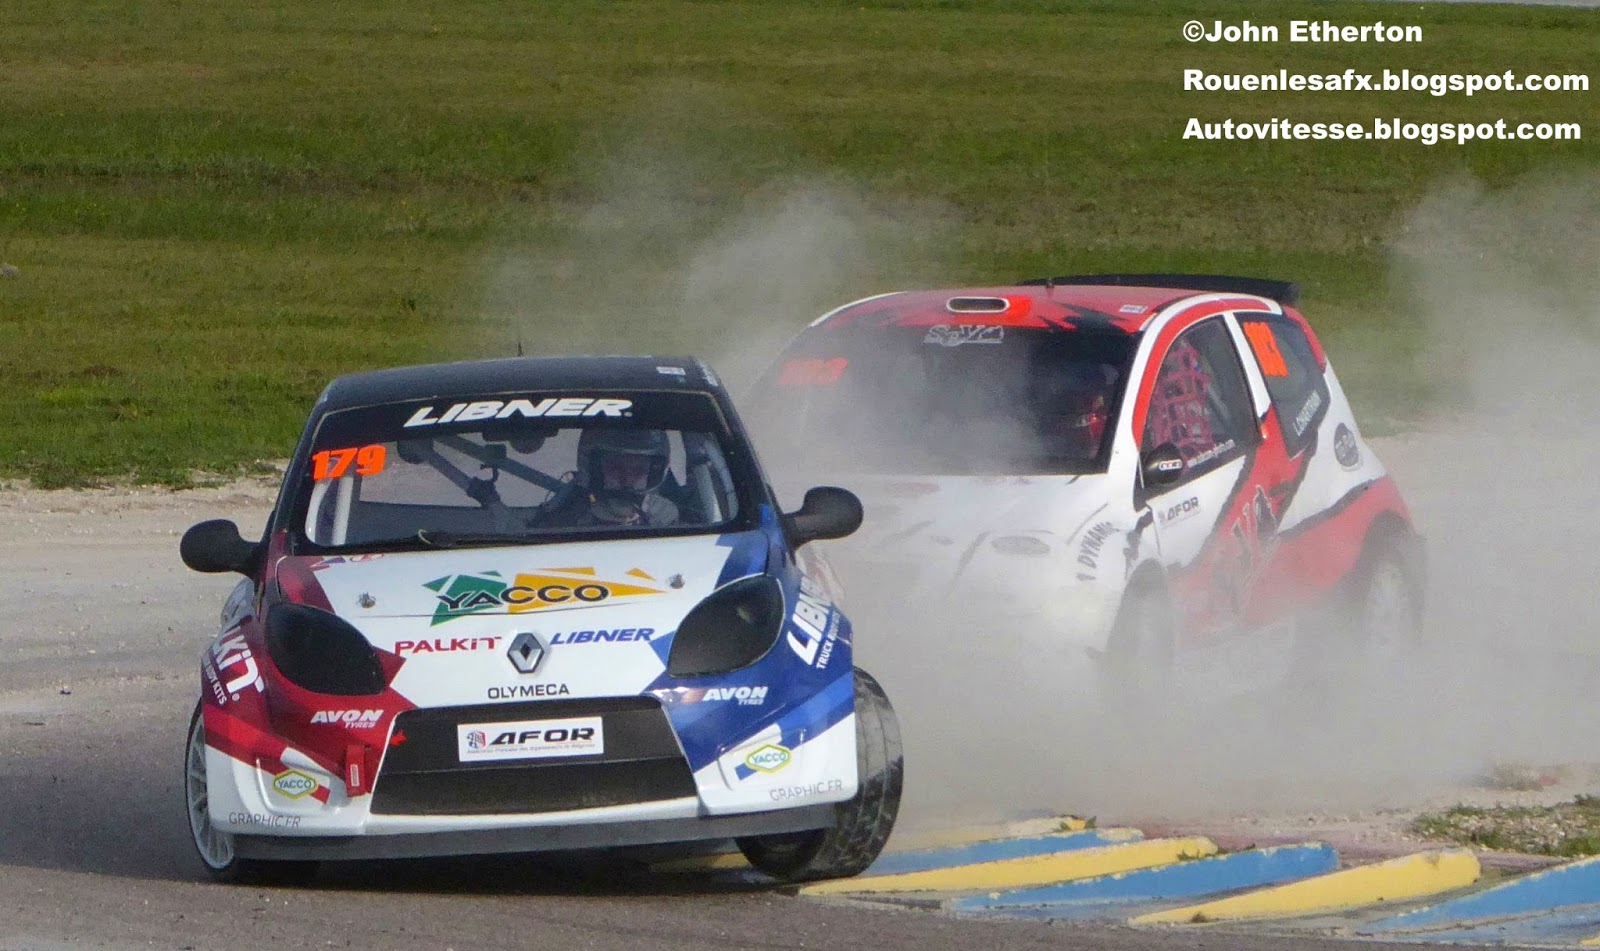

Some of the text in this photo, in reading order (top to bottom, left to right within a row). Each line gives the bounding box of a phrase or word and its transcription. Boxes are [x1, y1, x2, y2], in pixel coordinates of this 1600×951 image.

[403, 398, 633, 427] LIBNER
[312, 444, 386, 480] 179
[1167, 496, 1199, 520] AFOR
[435, 584, 610, 611] YACCO
[550, 628, 655, 646] LIBNER
[487, 683, 570, 700] OLYMECA
[703, 686, 768, 701] AVON
[310, 709, 385, 724] AVON
[345, 721, 377, 729] TYRES
[489, 727, 595, 746] AFOR
[752, 752, 787, 764] YACCO
[277, 779, 312, 789] YACCO
[769, 779, 843, 801] GRAPHIC.FR
[228, 811, 301, 828] GRAPHIC.FR
